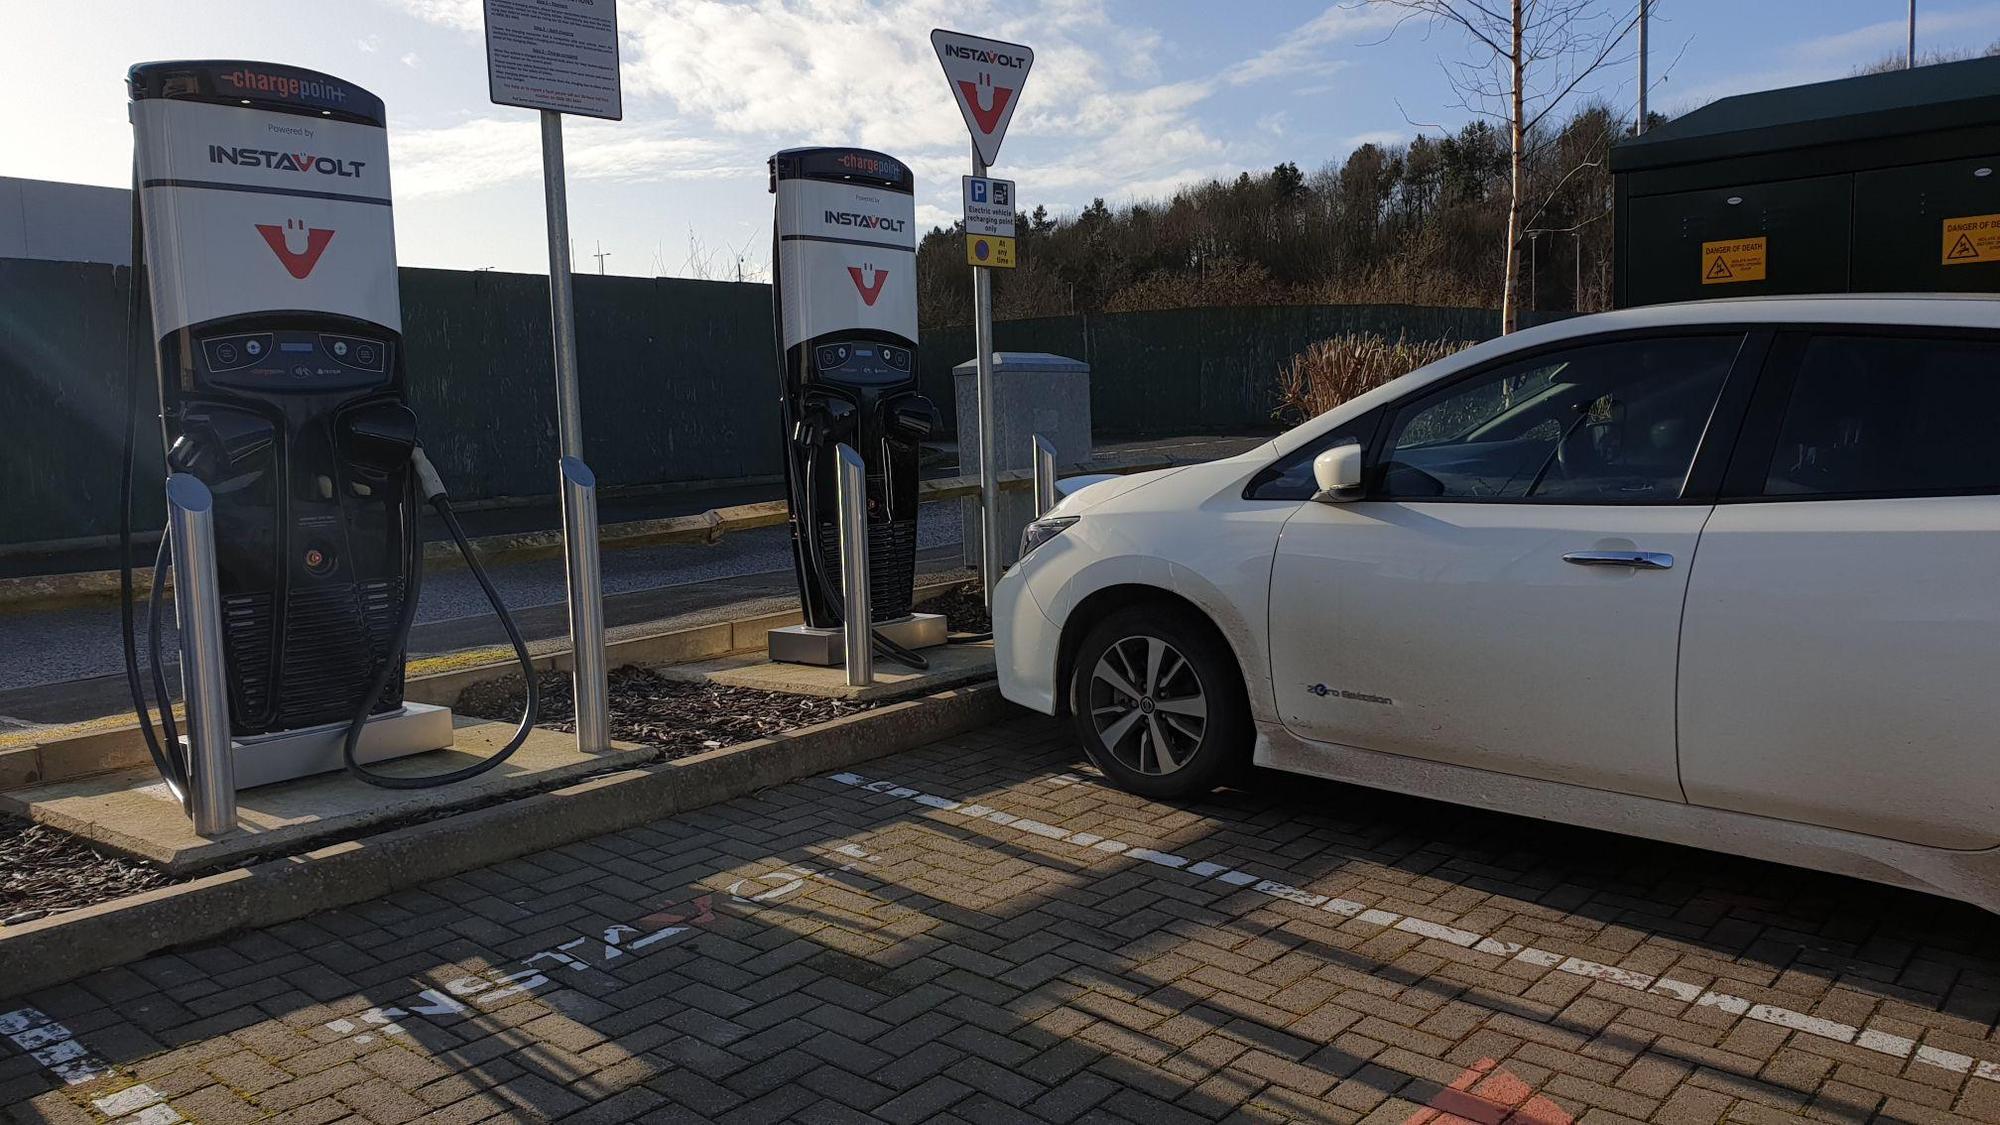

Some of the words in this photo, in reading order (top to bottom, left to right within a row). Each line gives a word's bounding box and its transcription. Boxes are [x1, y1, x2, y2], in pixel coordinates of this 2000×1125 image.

[945, 44, 1025, 69] INSTAVOLT
[268, 123, 302, 136] Powered
[304, 127, 314, 138] by
[209, 144, 366, 178] INSTAVOLT
[968, 205, 991, 215] Electric
[992, 208, 1012, 217] vehicle
[824, 210, 905, 233] INSTAVOLT
[967, 215, 998, 225] recharging
[999, 217, 1013, 226] point
[1947, 222, 1978, 232] DANGER
[1980, 221, 1990, 230] OF
[984, 224, 997, 233] only
[998, 249, 1008, 257] any
[1706, 245, 1730, 255] DANGER
[1733, 244, 1741, 252] OF
[1742, 243, 1763, 252] DEATH
[996, 257, 1008, 265] time
